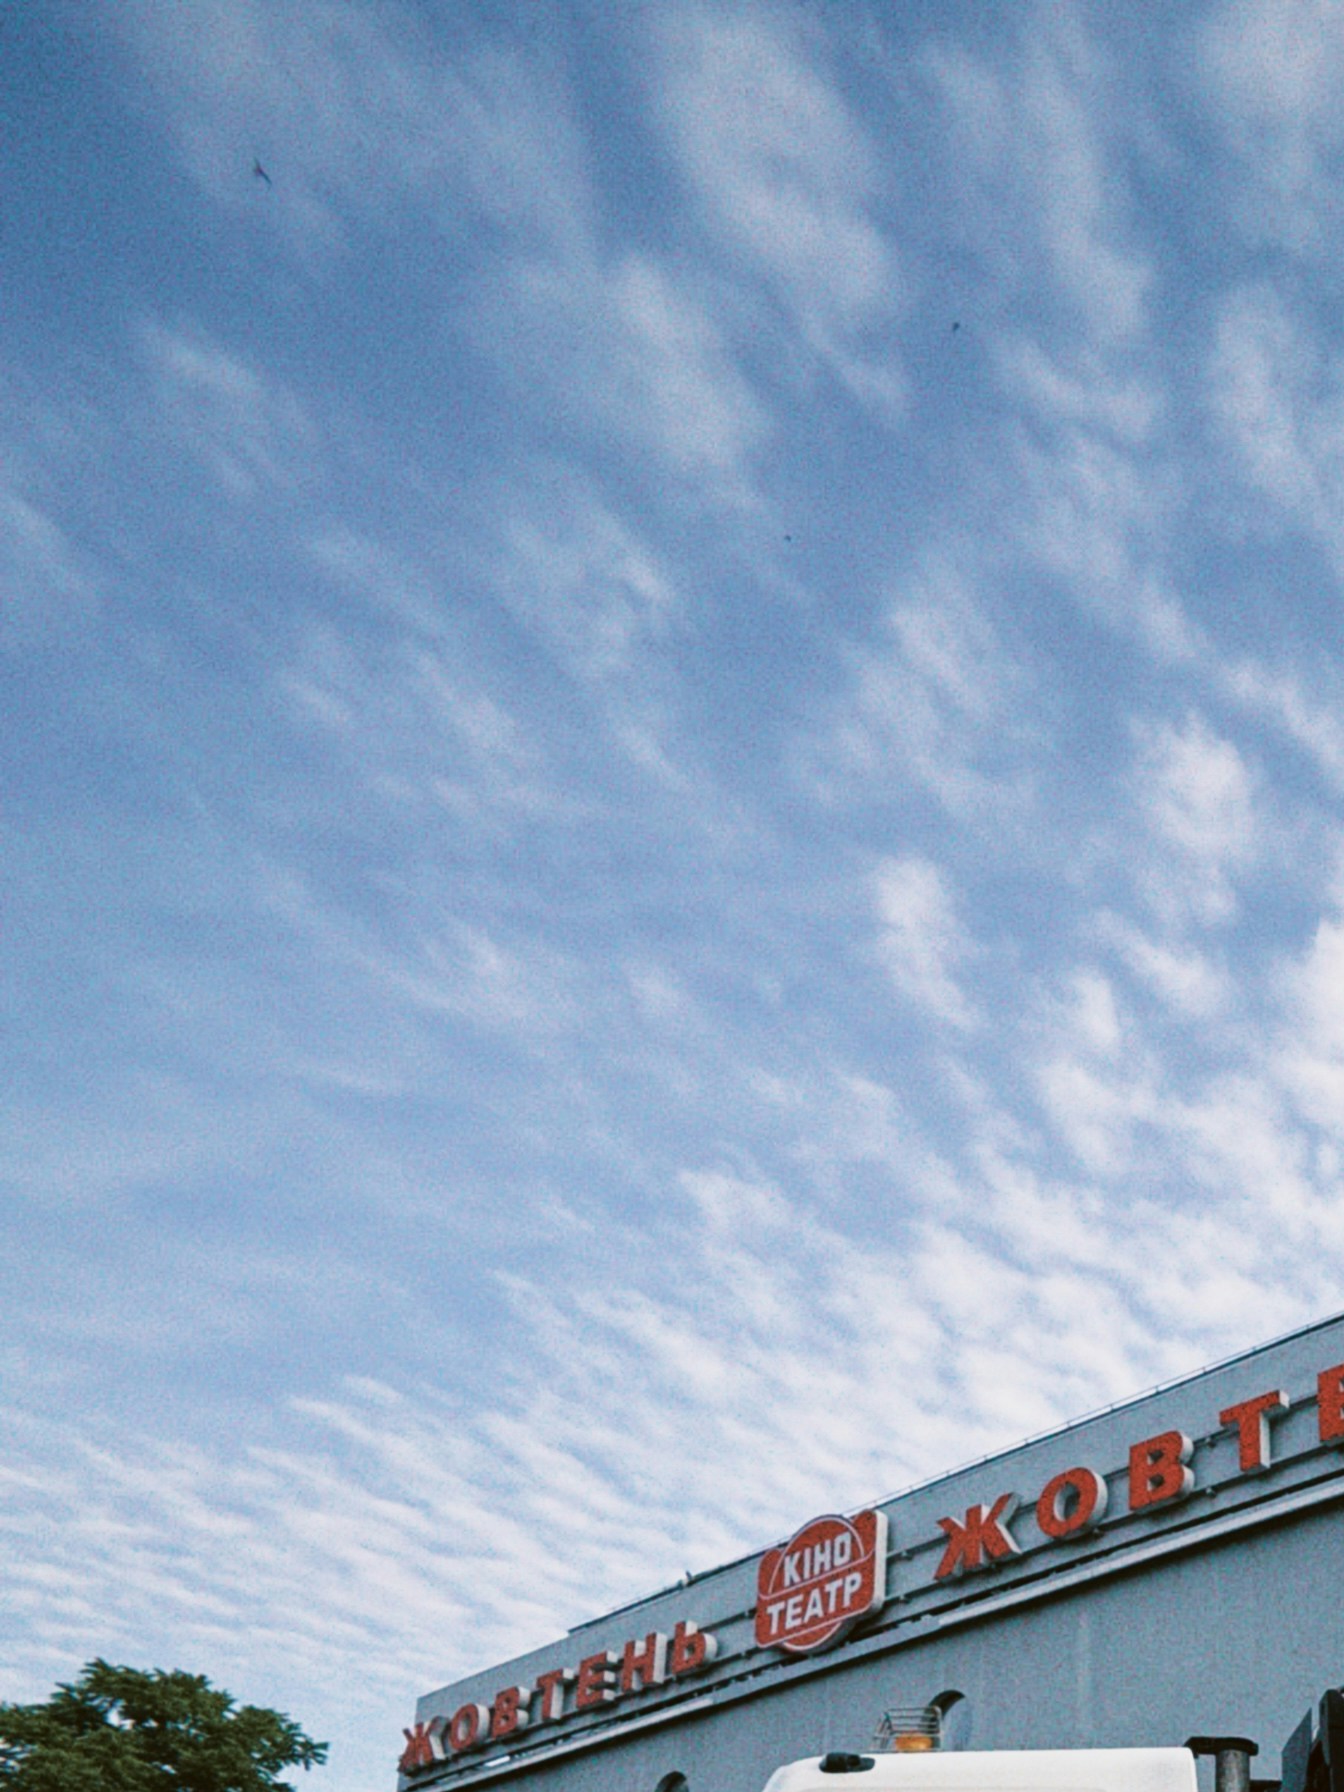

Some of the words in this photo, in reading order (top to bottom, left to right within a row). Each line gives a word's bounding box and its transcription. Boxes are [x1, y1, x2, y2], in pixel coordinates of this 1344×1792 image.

[783, 1531, 853, 1588] КІНО
[766, 1571, 863, 1636] ТЕАТР
[398, 1619, 718, 1777] ЖОВТЕНЬ
